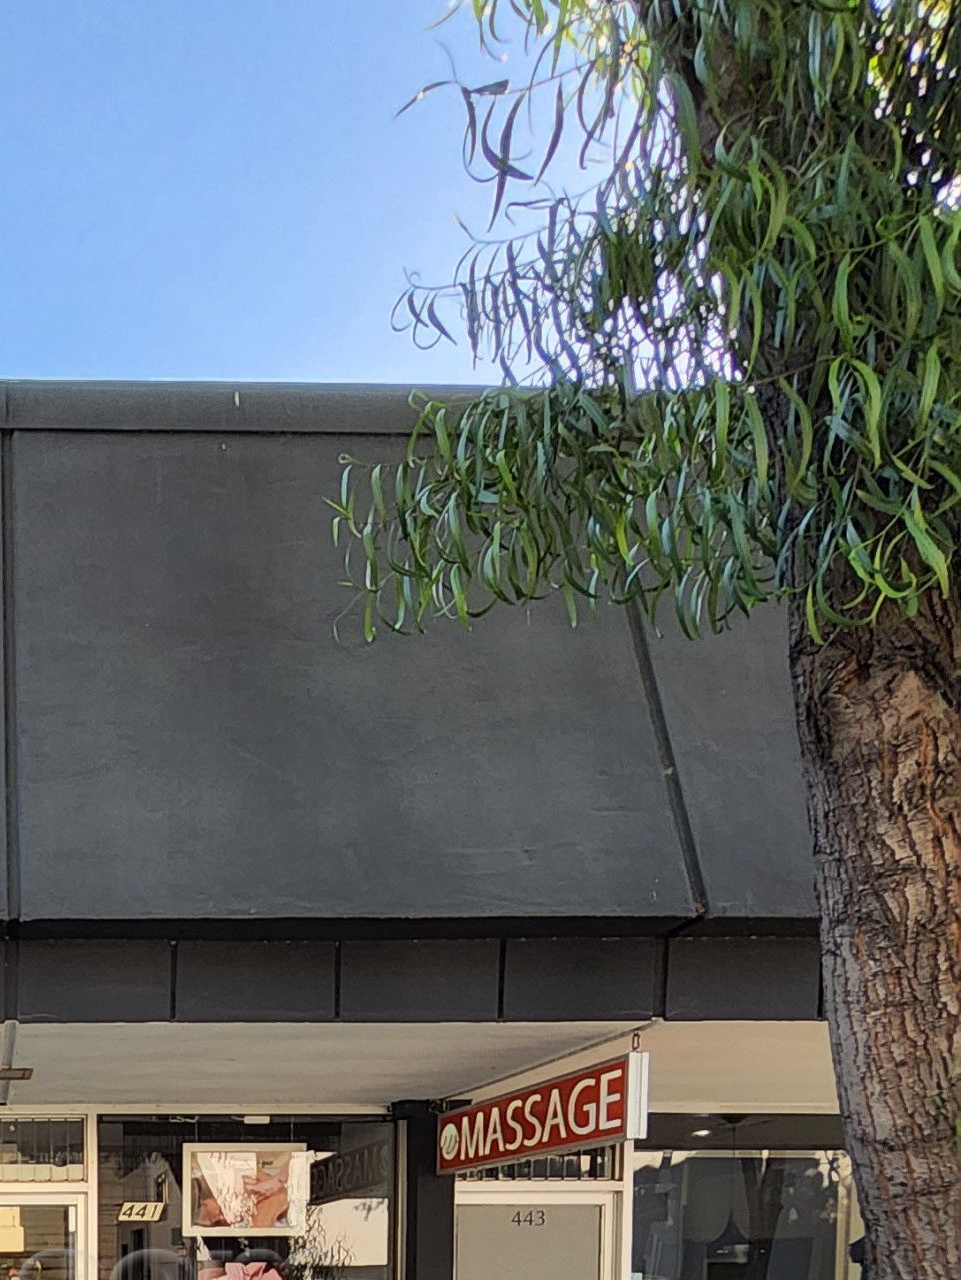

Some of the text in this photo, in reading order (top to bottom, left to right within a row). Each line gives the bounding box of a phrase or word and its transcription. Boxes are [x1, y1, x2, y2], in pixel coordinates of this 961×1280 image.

[459, 1068, 623, 1161] MASSAGE
[121, 1203, 157, 1218] 441
[511, 1210, 546, 1227] 443
